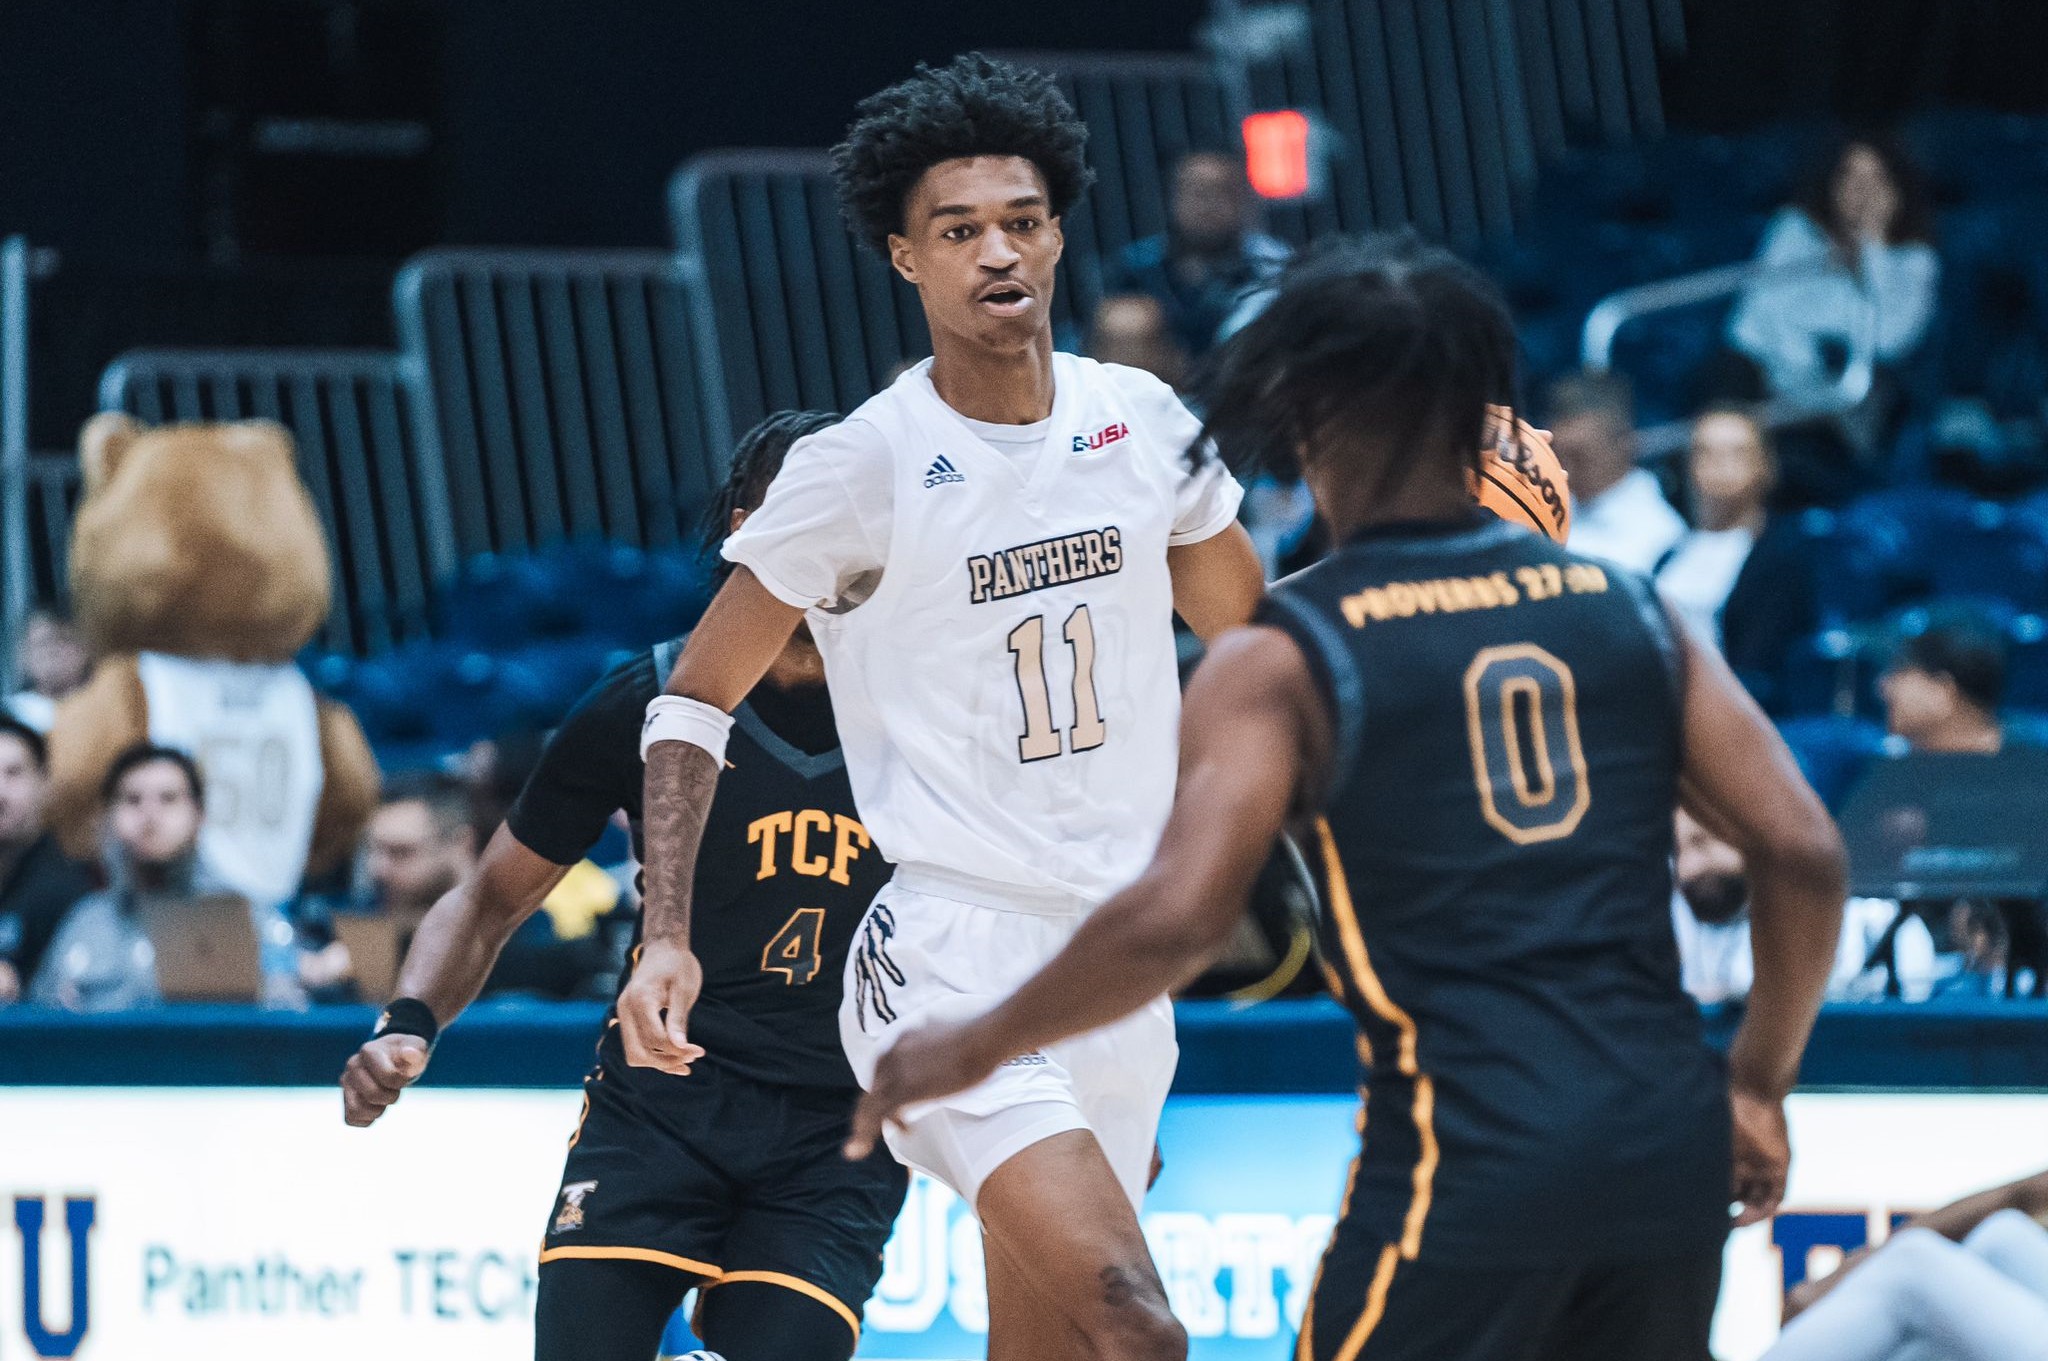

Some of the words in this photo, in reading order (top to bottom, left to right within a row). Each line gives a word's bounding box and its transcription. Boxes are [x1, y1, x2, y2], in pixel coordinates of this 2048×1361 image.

[923, 472, 965, 489] adidas
[968, 525, 1123, 604] PANTHERS
[1007, 603, 1105, 764] 11
[1463, 642, 1591, 845] 0
[747, 809, 871, 886] TCF
[761, 908, 826, 986] 4
[142, 1243, 365, 1316] Panther
